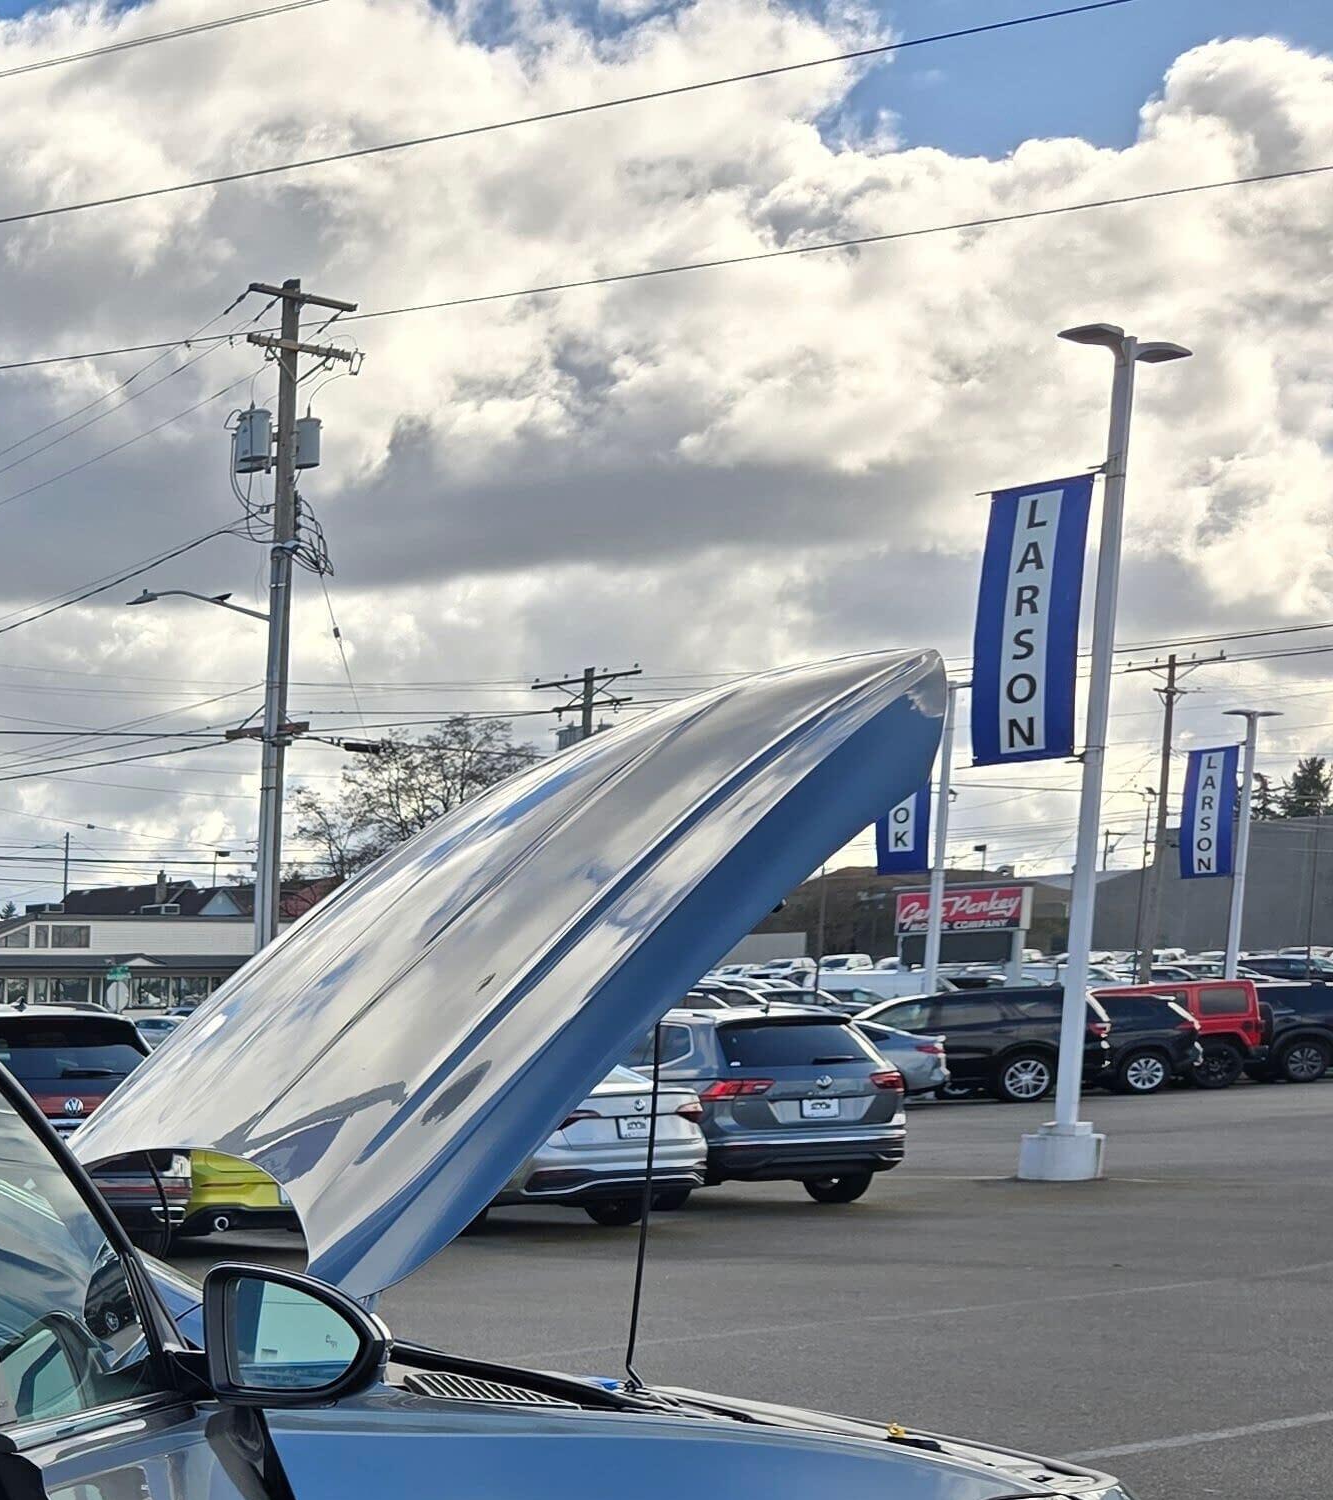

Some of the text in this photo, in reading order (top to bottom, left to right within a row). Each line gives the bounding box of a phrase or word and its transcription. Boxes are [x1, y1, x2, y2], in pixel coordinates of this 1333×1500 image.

[1006, 499, 1048, 749] LARSON
[1196, 755, 1217, 871] LARSON
[942, 891, 1020, 917] Pankey
[954, 919, 1010, 929] COMPANY
